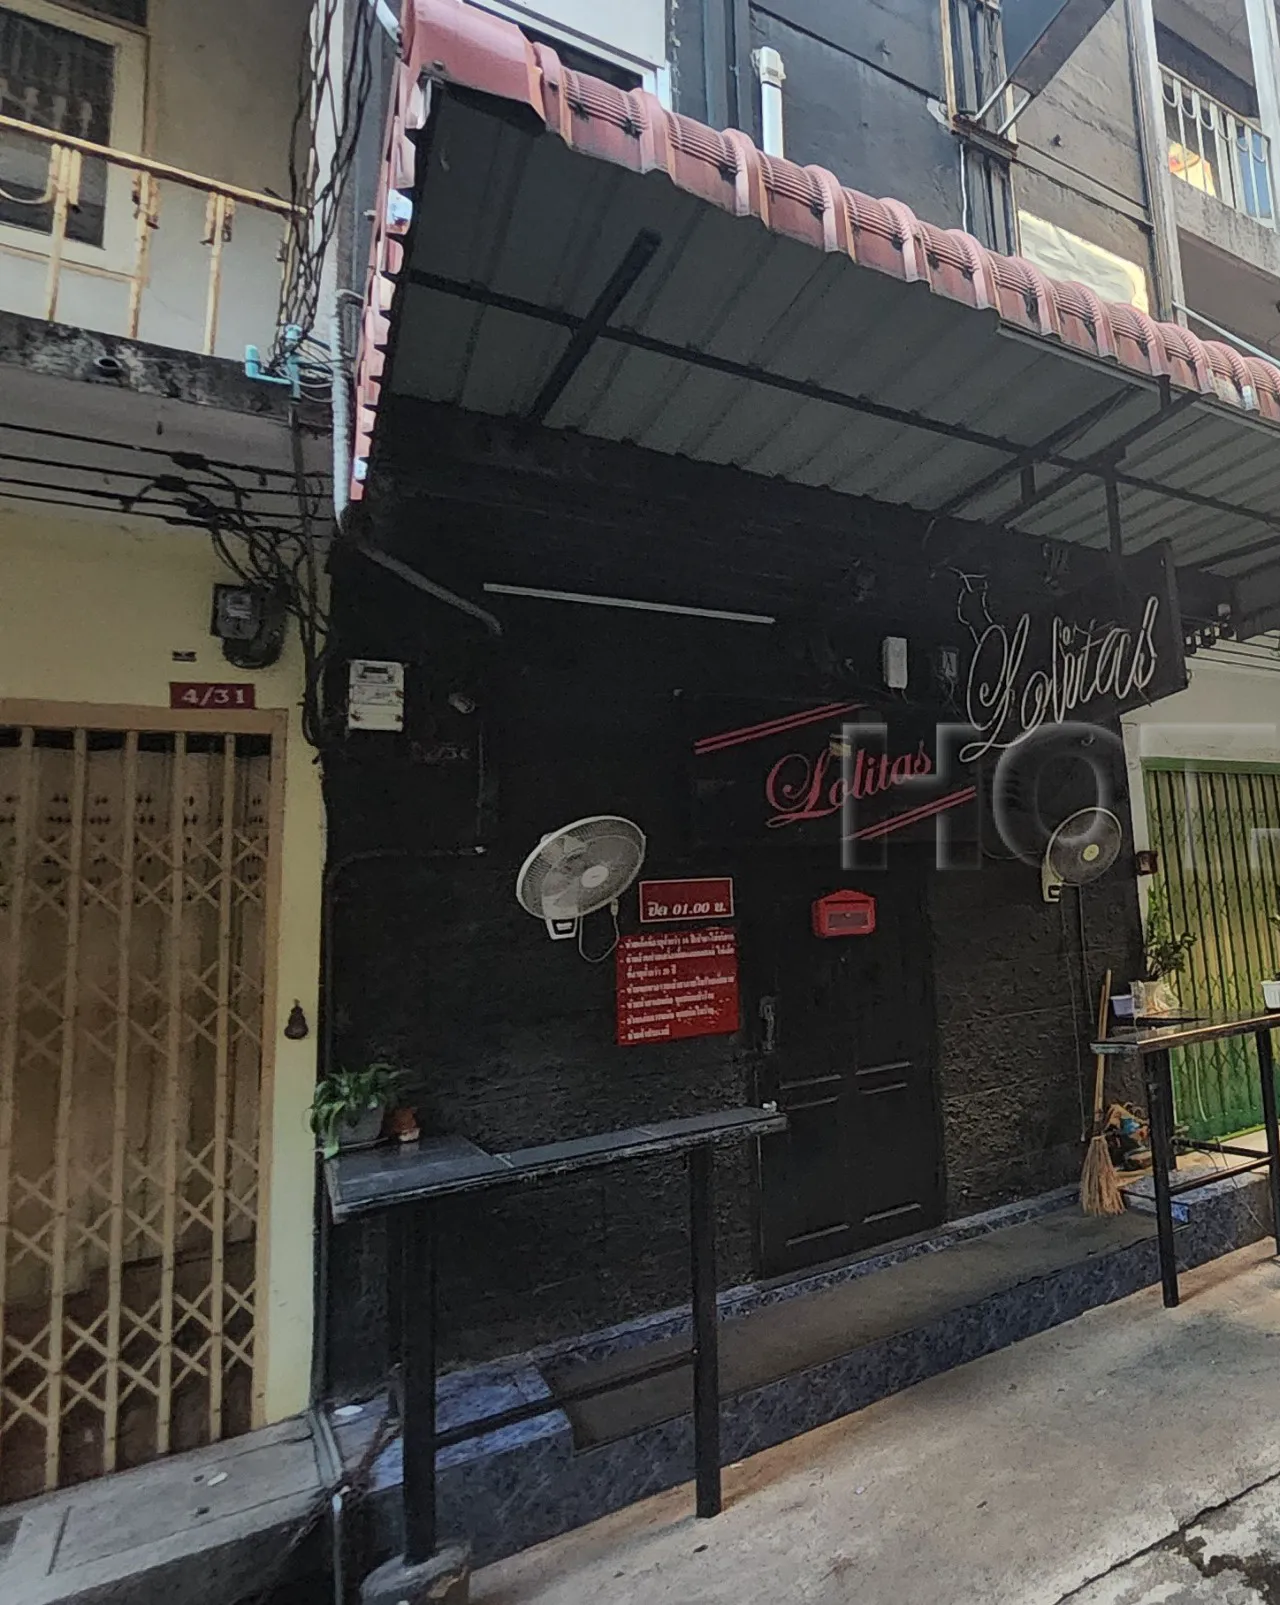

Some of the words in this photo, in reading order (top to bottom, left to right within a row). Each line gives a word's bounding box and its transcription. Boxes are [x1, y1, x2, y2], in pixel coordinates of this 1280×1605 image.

[181, 687, 246, 707] 4/31
[959, 597, 1159, 763] Lolitas
[765, 739, 933, 828] Lolitas
[672, 902, 710, 916] 01.00
